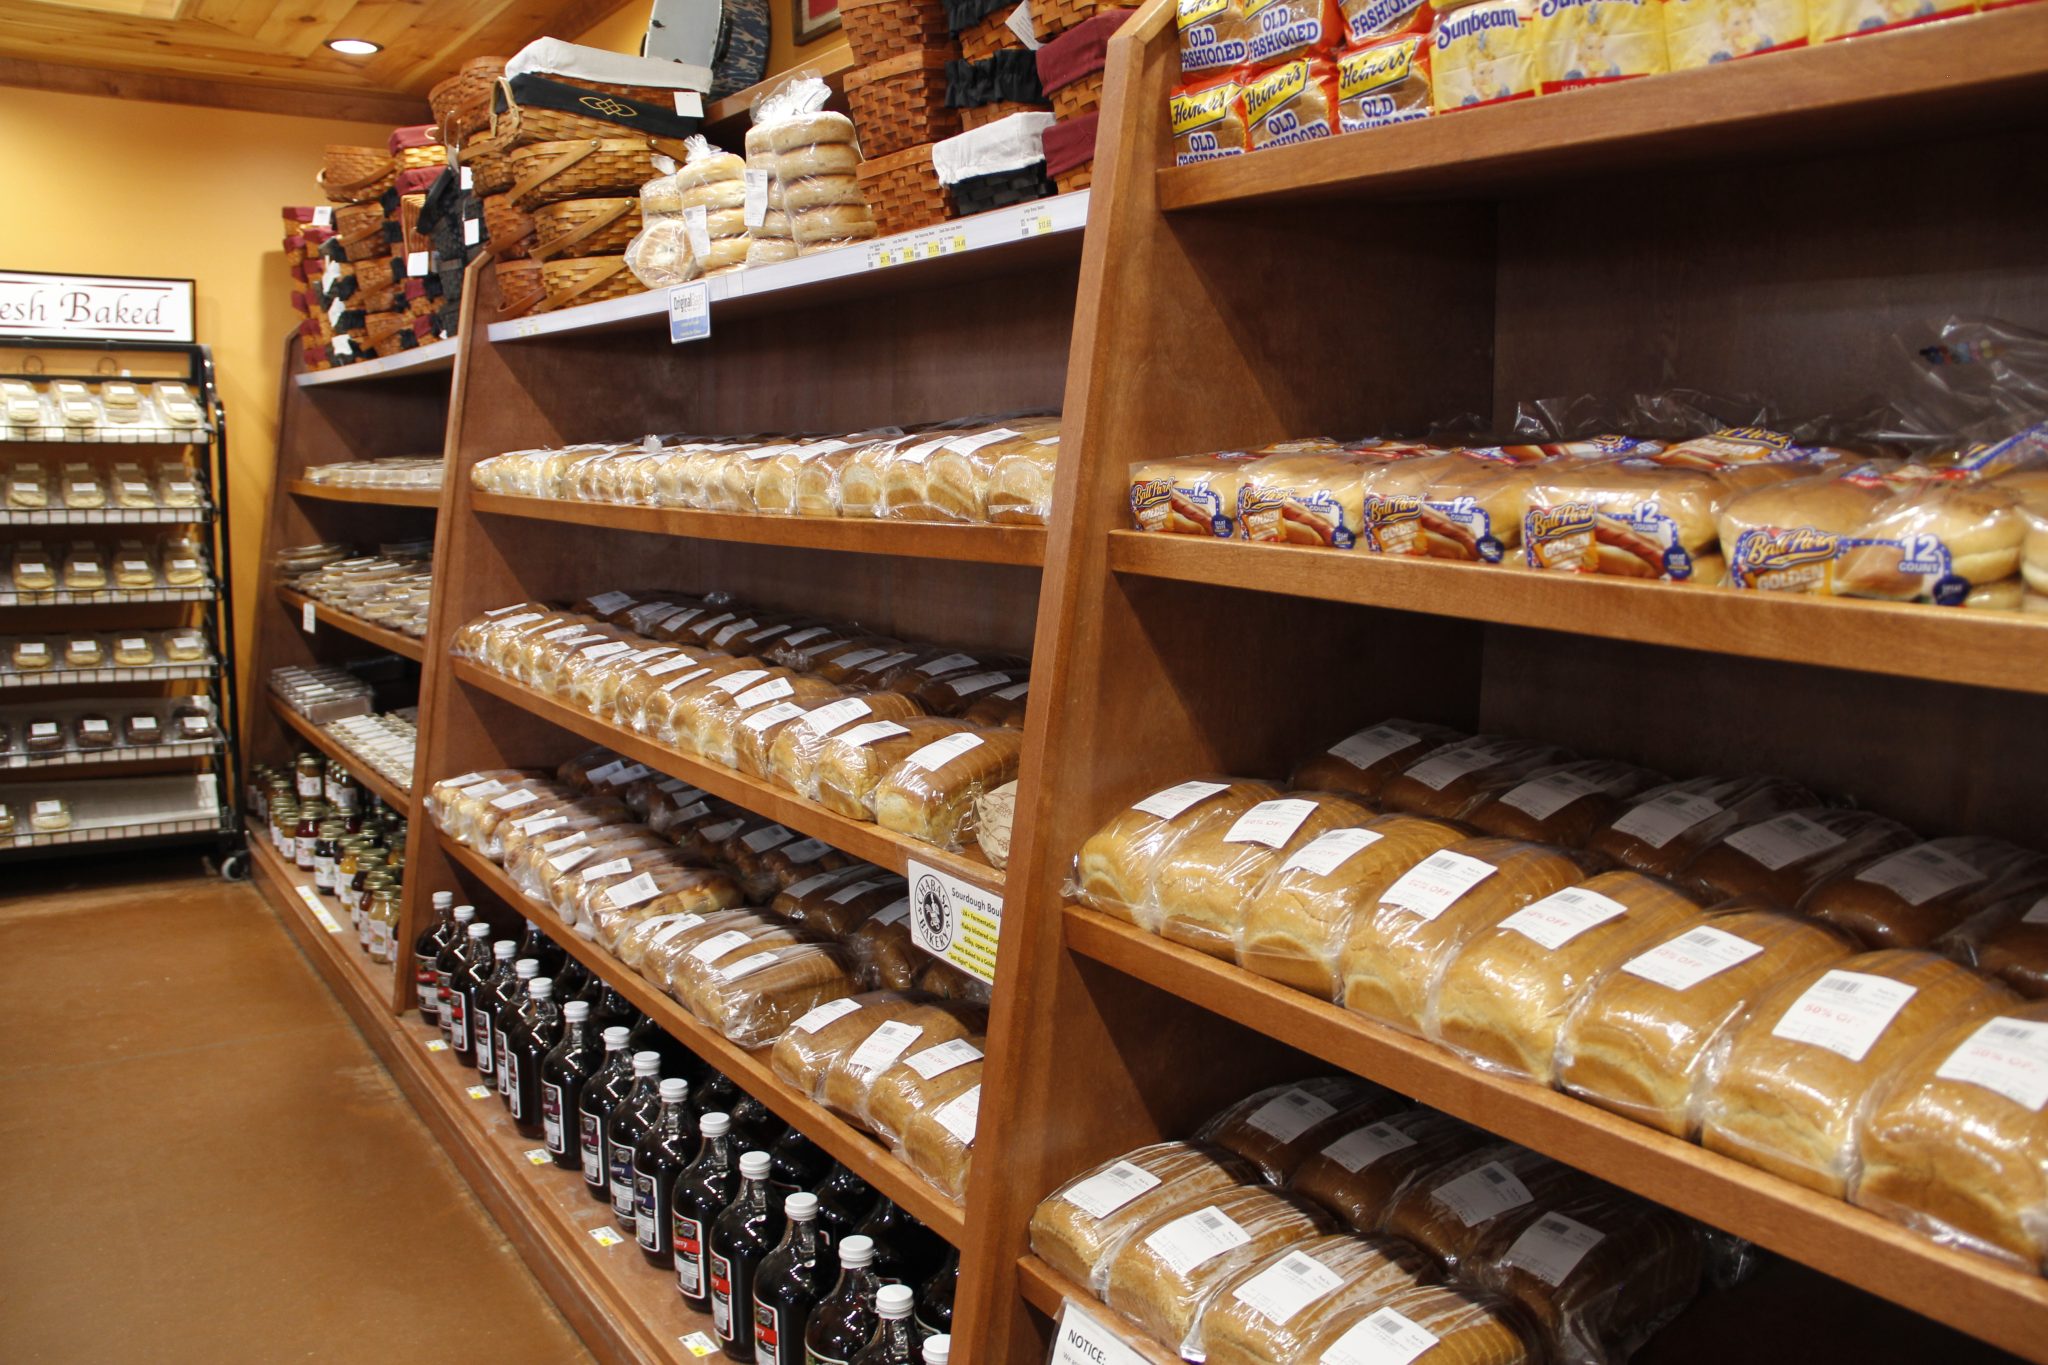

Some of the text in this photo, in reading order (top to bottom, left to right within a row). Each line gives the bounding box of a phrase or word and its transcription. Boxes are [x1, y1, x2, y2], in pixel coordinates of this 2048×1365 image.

[1263, 8, 1288, 32] OLD
[1350, 0, 1414, 37] FASHIO
[1437, 9, 1519, 49] Sunbeam
[1190, 28, 1214, 48] OLD
[1362, 98, 1393, 118] OLD
[1268, 112, 1297, 136] OLD
[1190, 133, 1215, 152] OLD
[60, 291, 169, 325] Baked
[1136, 483, 1153, 505] Ball
[1194, 481, 1209, 496] 12
[1312, 489, 1330, 505] 12
[1310, 505, 1331, 513] COUNT
[1453, 497, 1475, 514] 12
[1633, 502, 1659, 523] 12
[1532, 502, 1594, 537] Ball Park
[1747, 531, 1790, 566] Ball
[1902, 535, 1939, 562] 12
[1757, 565, 1825, 591] GOLDEN
[1899, 562, 1940, 573] COUNT
[917, 879, 950, 917] CHABASO
[952, 887, 986, 911] Sourdough
[920, 919, 949, 948] BAKERY
[1068, 1329, 1106, 1365] NOTICE:
